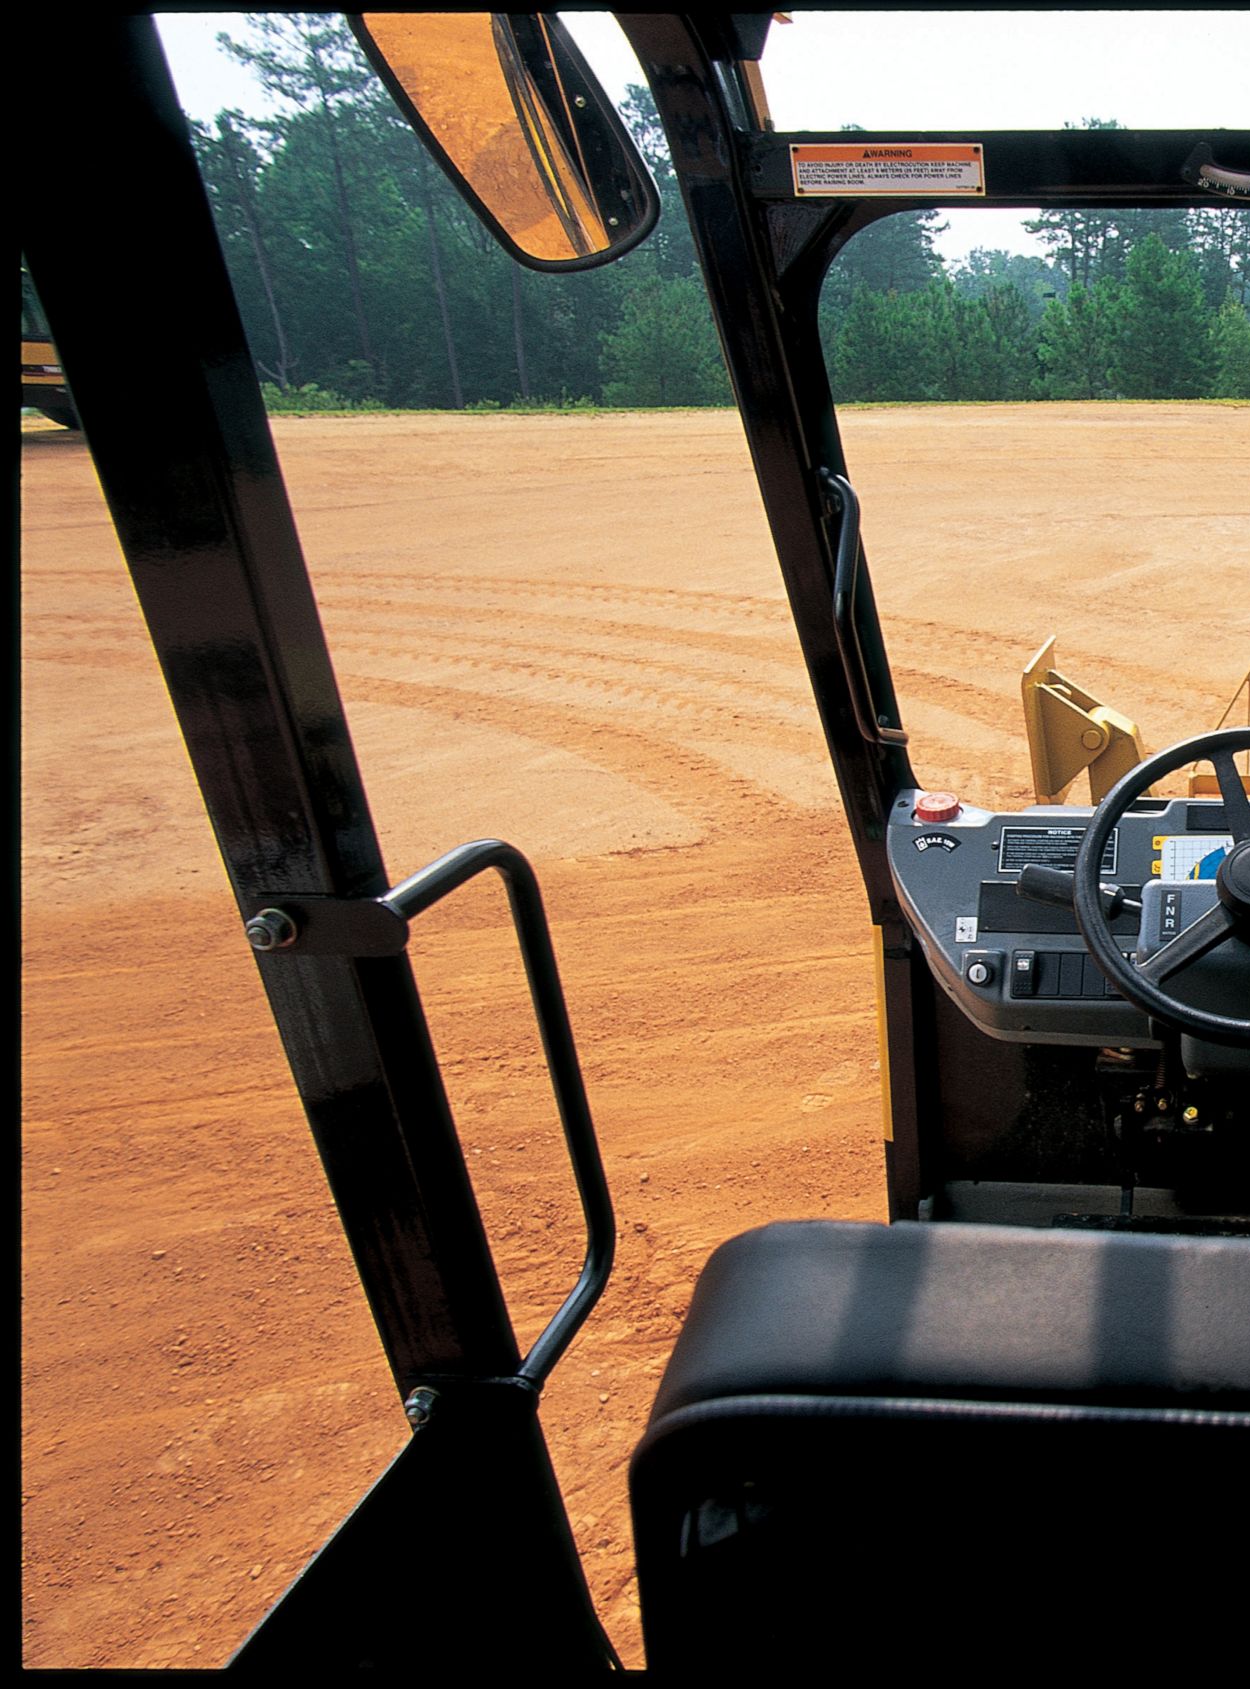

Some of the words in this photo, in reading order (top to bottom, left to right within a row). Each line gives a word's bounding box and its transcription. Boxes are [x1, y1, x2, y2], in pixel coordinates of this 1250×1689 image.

[870, 149, 912, 158] WARNING
[1198, 178, 1209, 188] 20
[1167, 894, 1176, 903] F
[1166, 906, 1175, 915] N
[1165, 918, 1175, 928] R
